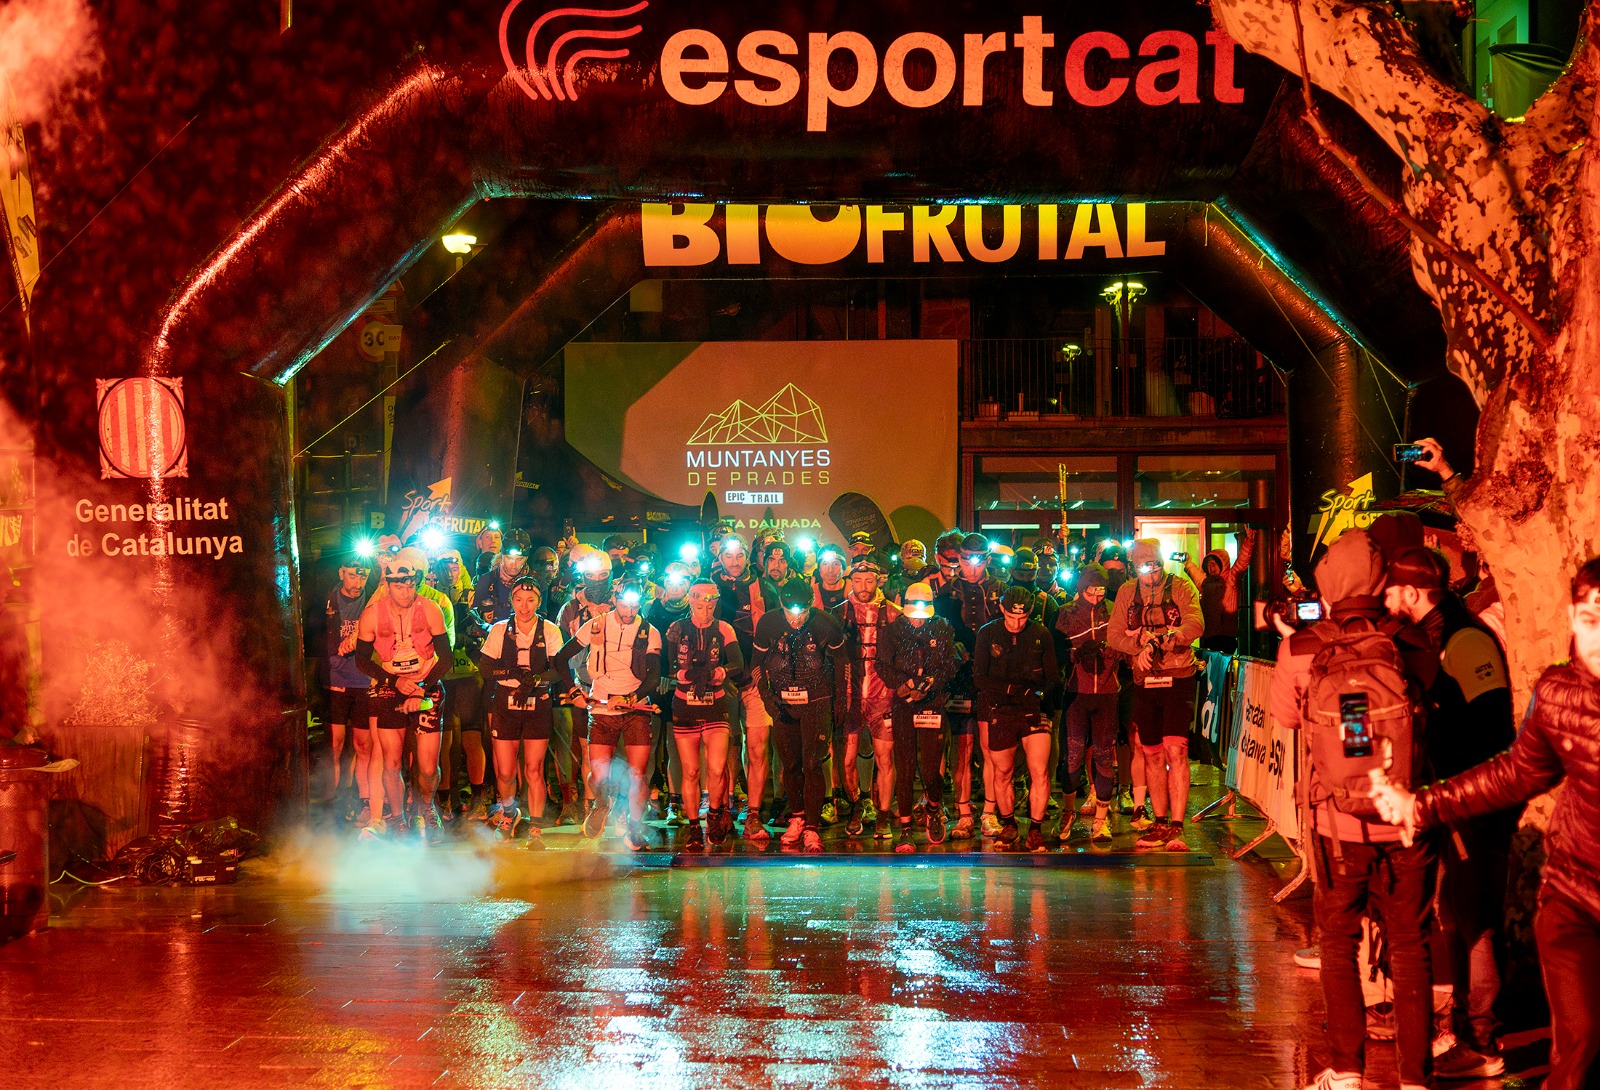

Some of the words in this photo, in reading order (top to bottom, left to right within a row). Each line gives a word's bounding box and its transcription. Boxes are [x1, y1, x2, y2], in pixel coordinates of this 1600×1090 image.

[660, 15, 1245, 132] esportcat
[686, 449, 831, 468] MUNTANYES
[688, 472, 717, 486] DE
[730, 470, 830, 486] PRADES
[75, 497, 229, 523] Generalitat
[402, 490, 452, 518] Sport
[727, 492, 745, 502] EPIC
[751, 493, 780, 503] TRAIL
[1319, 490, 1376, 519] Sport
[749, 518, 822, 529] DAURADA
[66, 534, 93, 557] de
[101, 531, 243, 560] Catalunya
